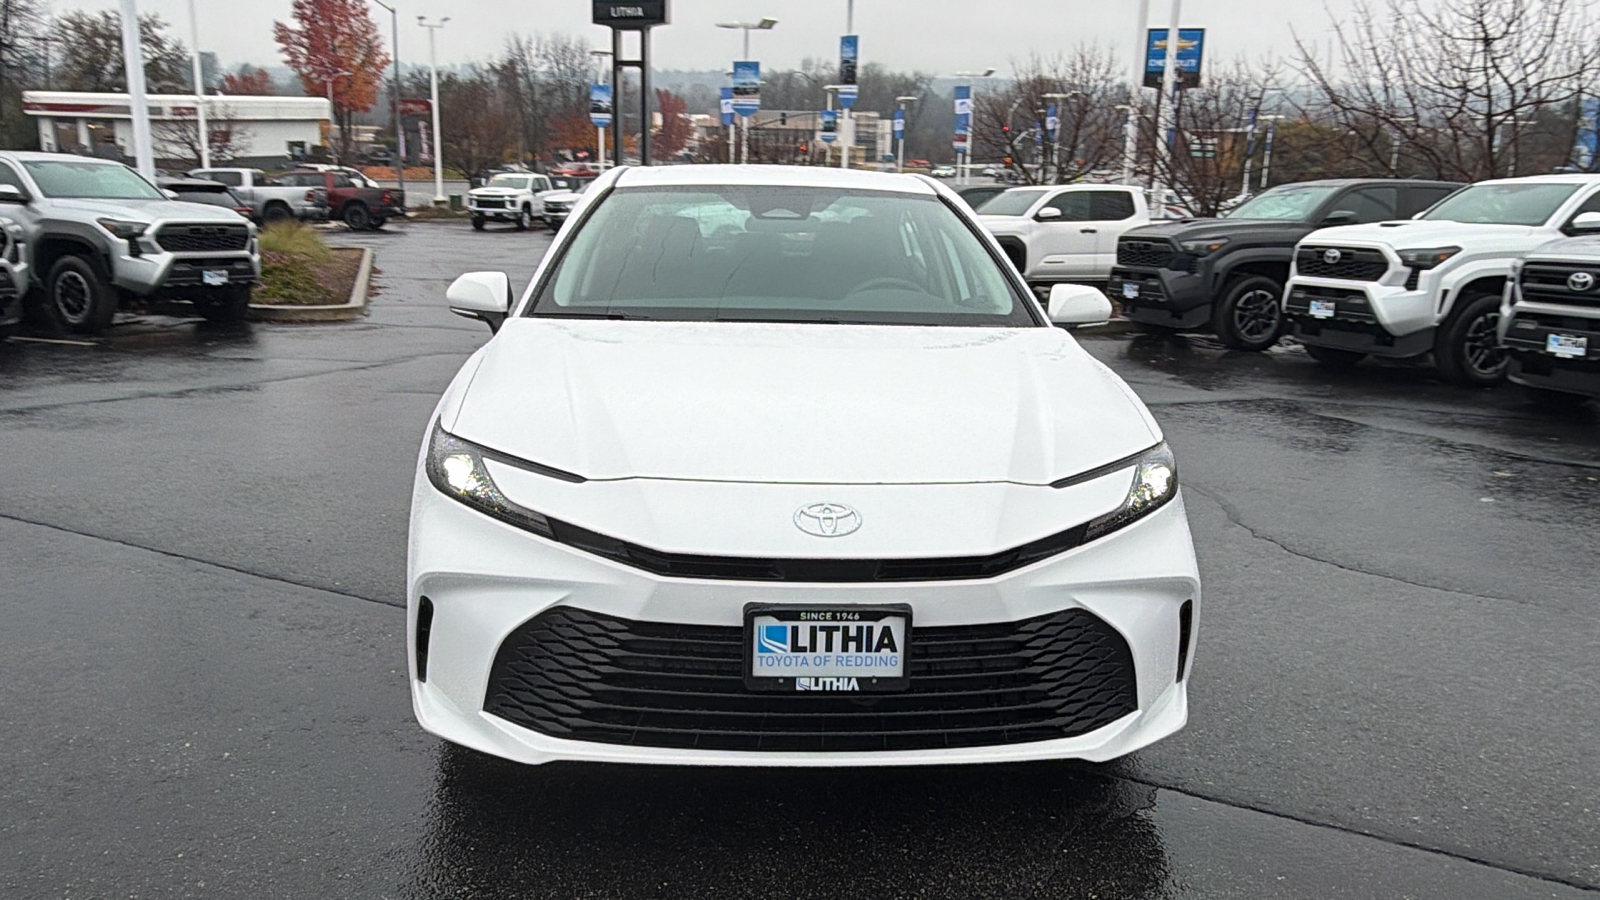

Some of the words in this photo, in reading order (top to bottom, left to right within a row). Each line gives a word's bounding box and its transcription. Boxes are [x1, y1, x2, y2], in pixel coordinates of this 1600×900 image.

[610, 6, 644, 18] LITHIA
[1148, 59, 1197, 67] CHEOLET
[800, 611, 833, 620] SINCE
[836, 611, 860, 620] 1946
[792, 626, 898, 652] LITHIA
[758, 656, 809, 667] TOYOTA
[813, 656, 830, 667] OF
[836, 656, 898, 667] REDDING
[810, 678, 860, 690] LITHIA
